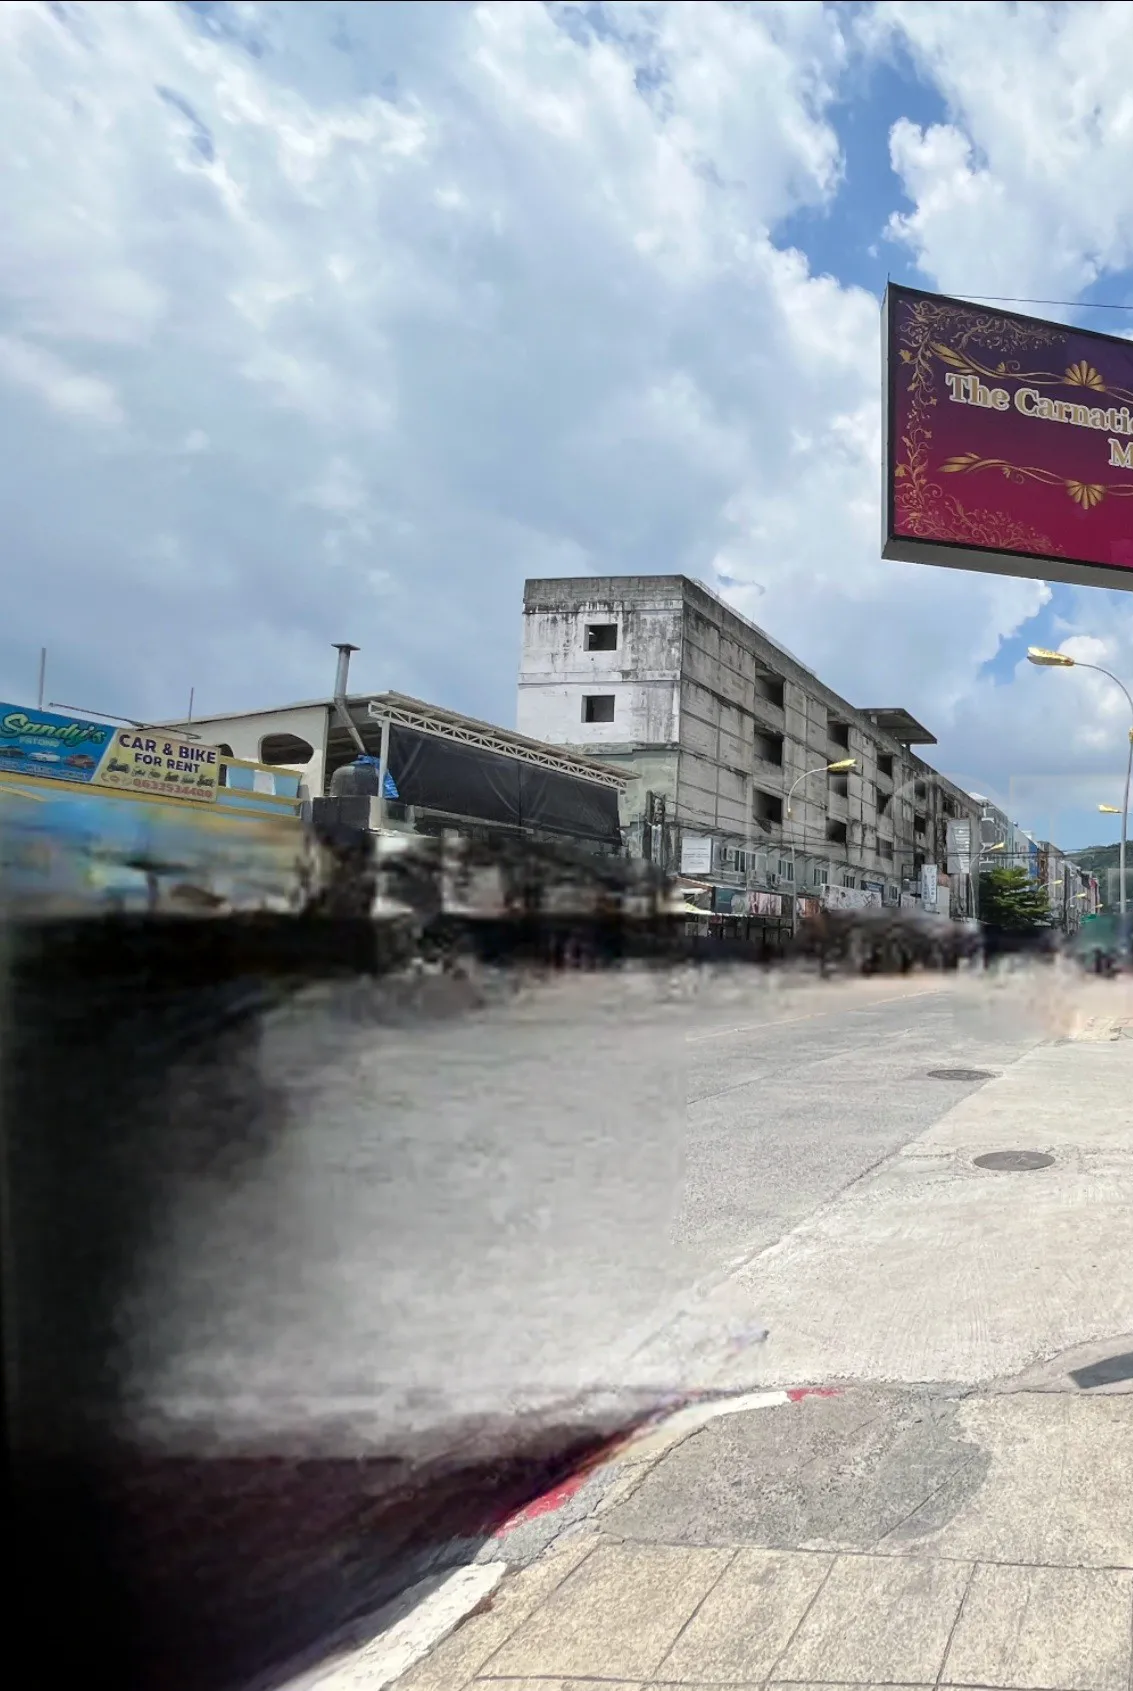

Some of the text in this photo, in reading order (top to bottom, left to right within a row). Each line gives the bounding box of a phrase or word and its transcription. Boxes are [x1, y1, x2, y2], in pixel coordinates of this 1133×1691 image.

[945, 372, 1010, 411] The
[1, 712, 107, 747] Sandy's
[119, 734, 216, 764] CAR & BIKE
[134, 753, 200, 773] FOR RENT
